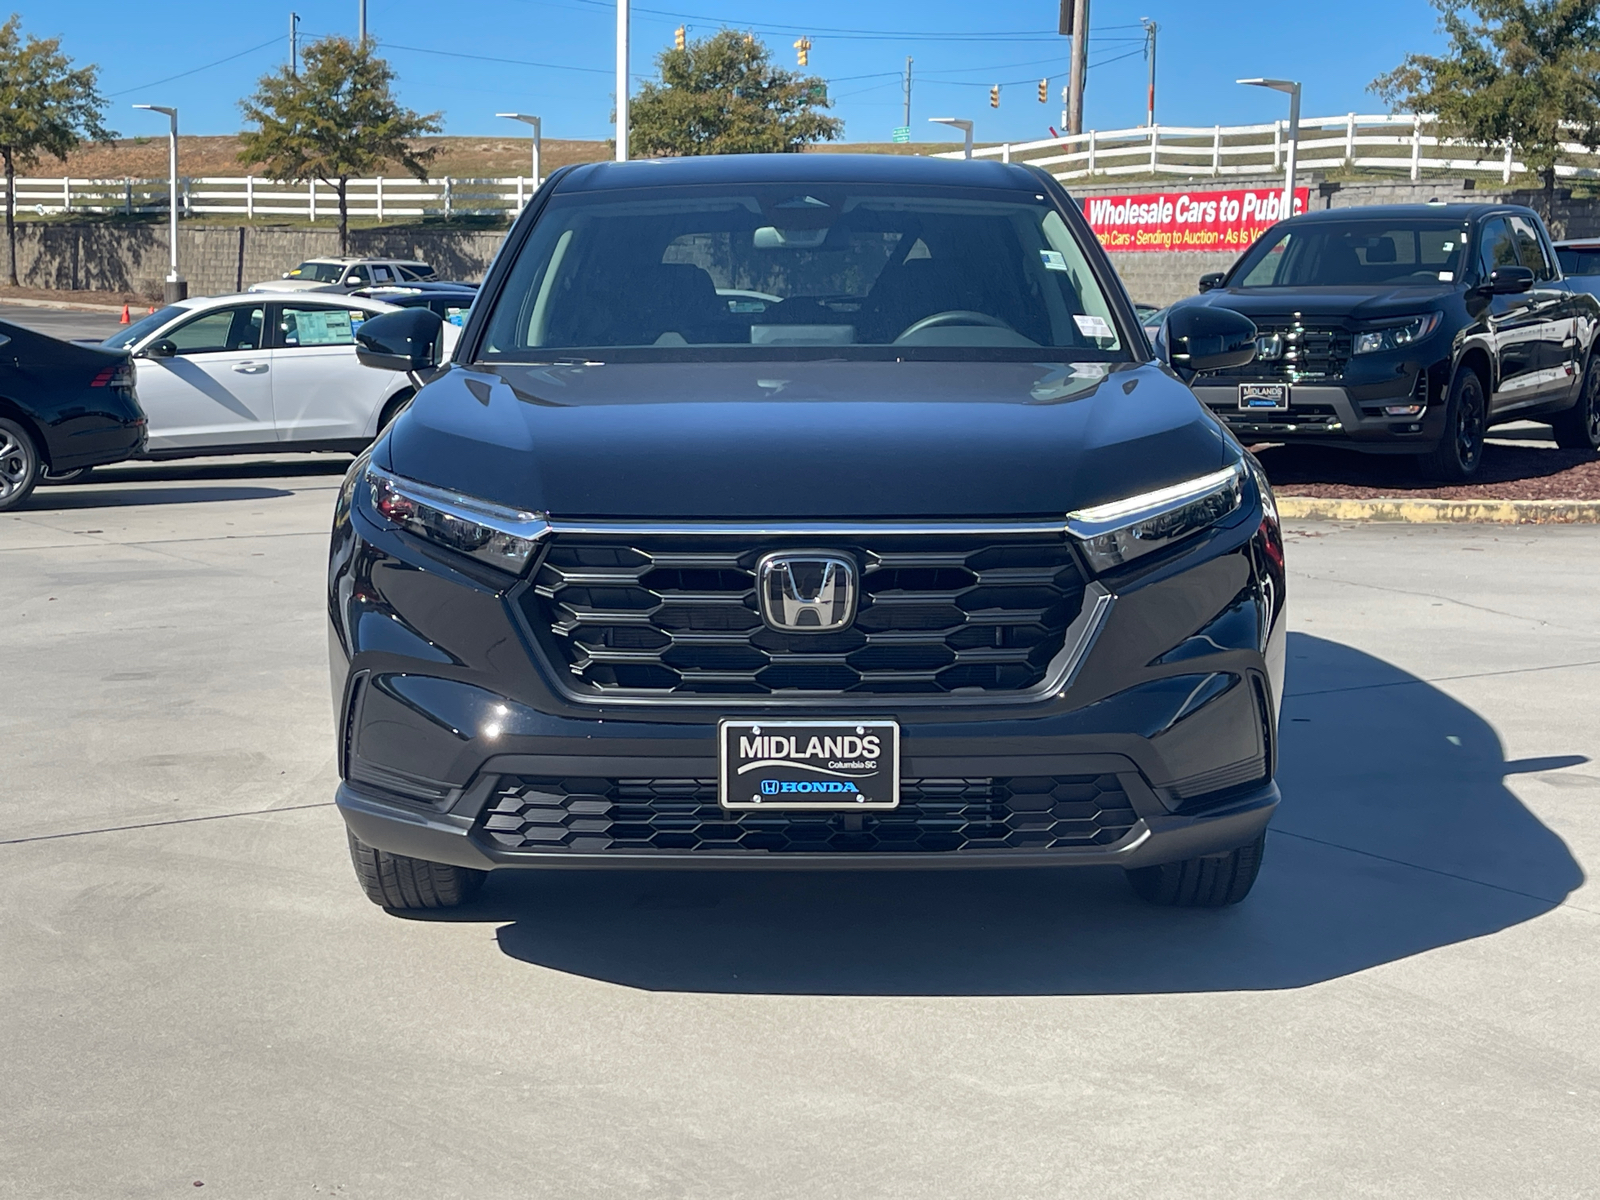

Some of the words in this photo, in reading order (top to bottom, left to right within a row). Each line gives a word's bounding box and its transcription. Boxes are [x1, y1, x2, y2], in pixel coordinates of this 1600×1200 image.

[1090, 196, 1173, 225] Wholesale
[1175, 195, 1217, 223] Cars
[1220, 196, 1239, 222] to
[1242, 191, 1303, 221] Publc
[1111, 230, 1130, 245] Cars
[1136, 229, 1171, 248] Sending
[1173, 230, 1182, 244] to
[1183, 229, 1218, 245] Auction
[1225, 228, 1238, 244] As
[1240, 227, 1249, 244] Is
[739, 736, 881, 759] MIDLANDS
[828, 760, 865, 769] Columbia
[864, 760, 877, 769] SC
[780, 782, 859, 793] HONDA
